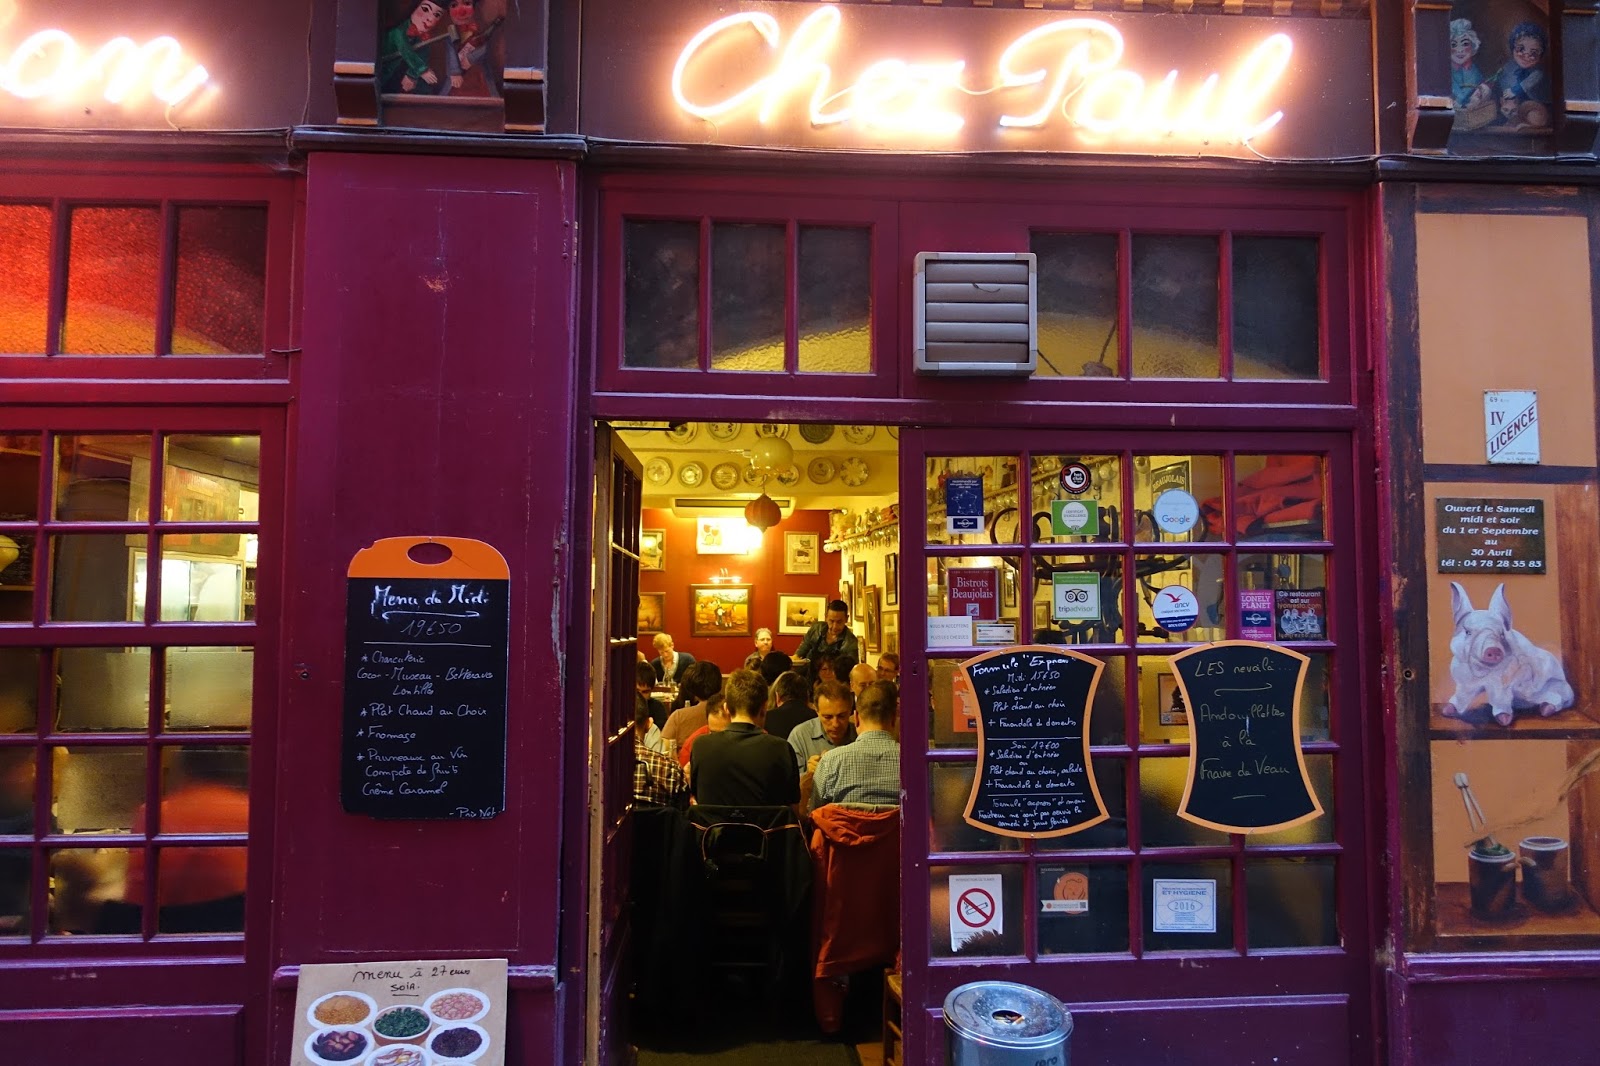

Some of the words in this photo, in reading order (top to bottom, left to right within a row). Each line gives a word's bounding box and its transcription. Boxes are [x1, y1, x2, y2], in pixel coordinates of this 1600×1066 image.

[672, 5, 965, 129] Chez
[998, 18, 1285, 142] Paul
[1490, 411, 1505, 426] IV
[1490, 405, 1535, 456] LICENCE
[1444, 504, 1481, 512] Ouvert
[1484, 504, 1494, 513] le
[1496, 505, 1536, 513] Samedi
[1162, 514, 1190, 525] Google
[1500, 516, 1520, 524] soir
[1482, 527, 1539, 536] Septembre
[1471, 548, 1484, 556] 30
[1487, 549, 1512, 557] Avril
[956, 576, 988, 588] Bistrots
[371, 585, 419, 607] Menu
[448, 584, 490, 604] Midi
[952, 587, 993, 600] Beaujolais
[391, 667, 432, 680] Museau
[973, 657, 1019, 677] Formule
[1195, 660, 1224, 677] LES
[369, 703, 393, 716] Plat
[398, 704, 433, 716] Chaud
[440, 708, 453, 716] au
[457, 704, 487, 716] Choix
[367, 725, 416, 743] Fromage
[1222, 736, 1231, 747] à
[367, 748, 425, 761] Pruneaux
[450, 746, 468, 759] Vin
[1255, 755, 1290, 775] Veau
[365, 765, 412, 781] Compote
[398, 781, 448, 794] Caramel
[1174, 901, 1195, 910] 2016
[432, 965, 447, 977] 27
